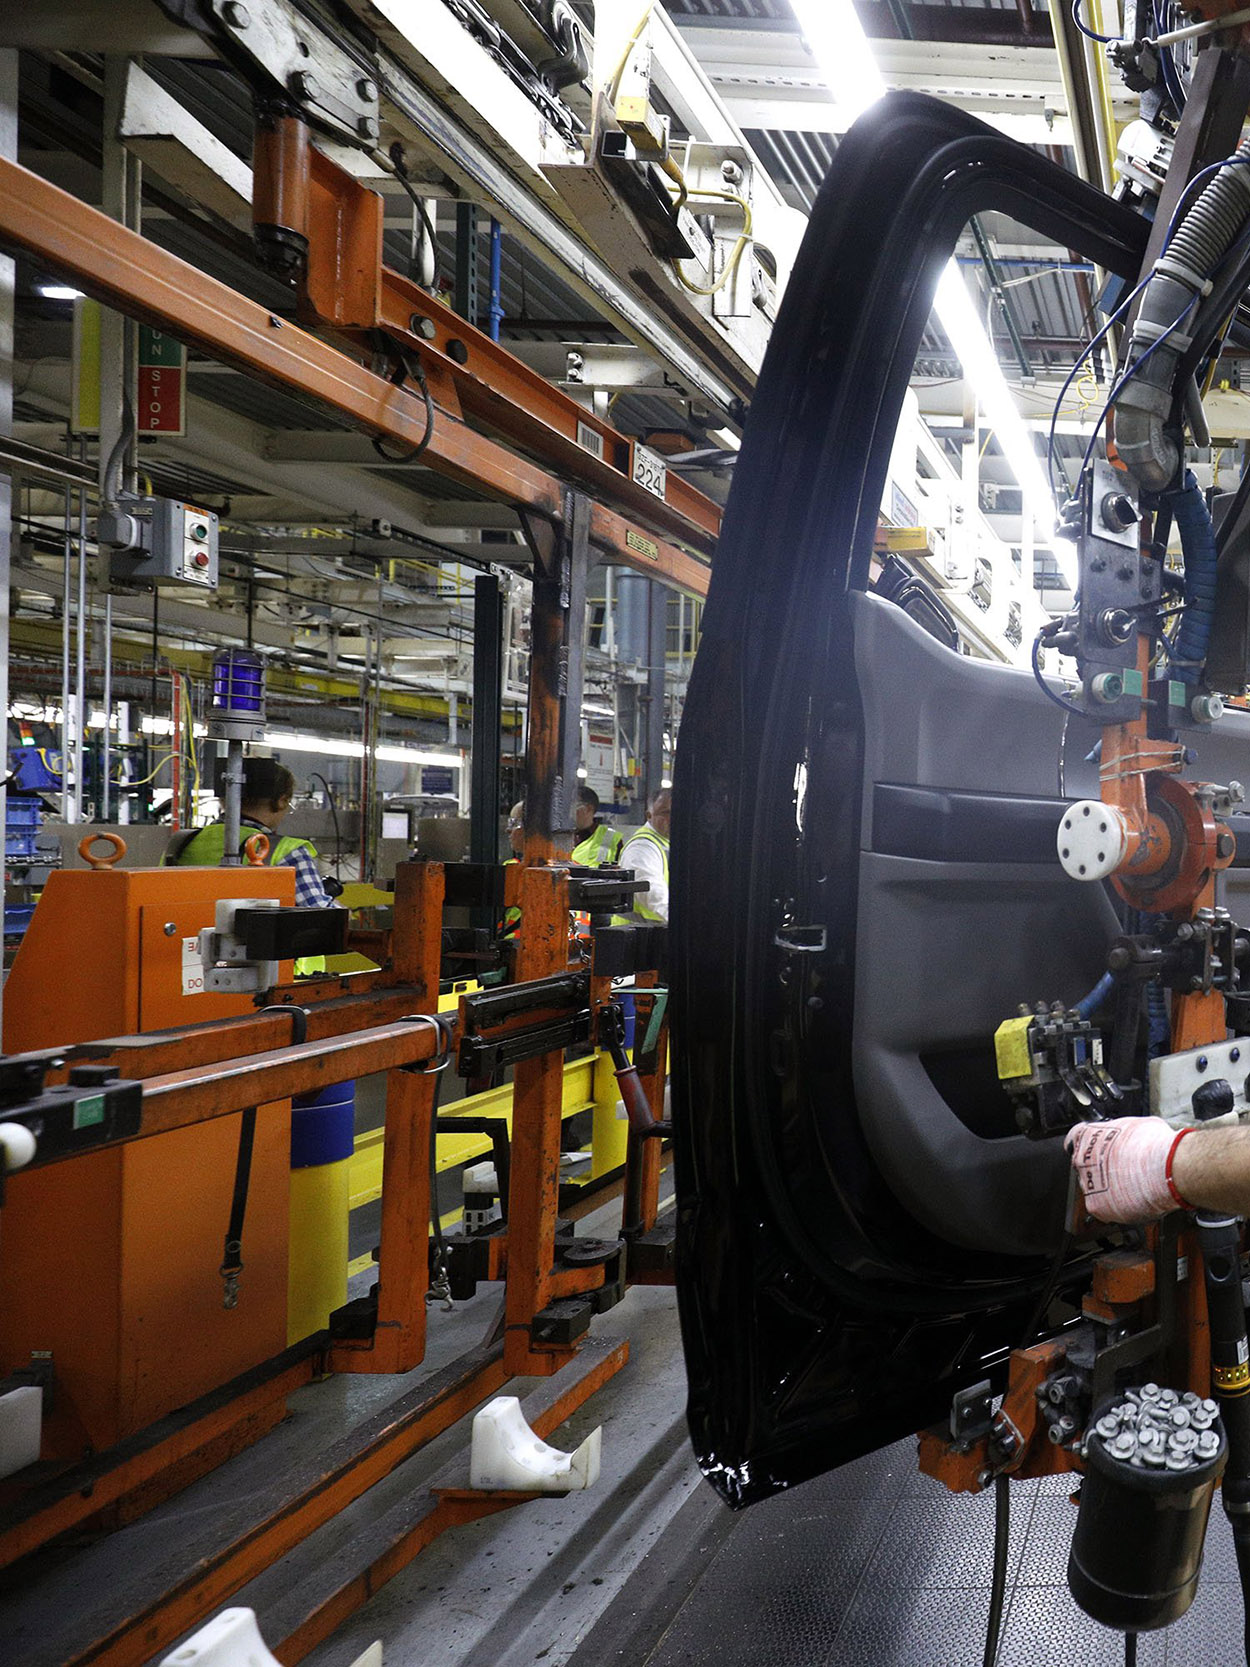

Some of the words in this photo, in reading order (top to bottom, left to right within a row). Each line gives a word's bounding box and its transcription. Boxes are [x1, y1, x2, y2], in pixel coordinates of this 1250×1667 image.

[151, 329, 162, 356] UN
[150, 370, 161, 429] STOP
[637, 463, 663, 496] 224
[1086, 1171, 1095, 1190] De
